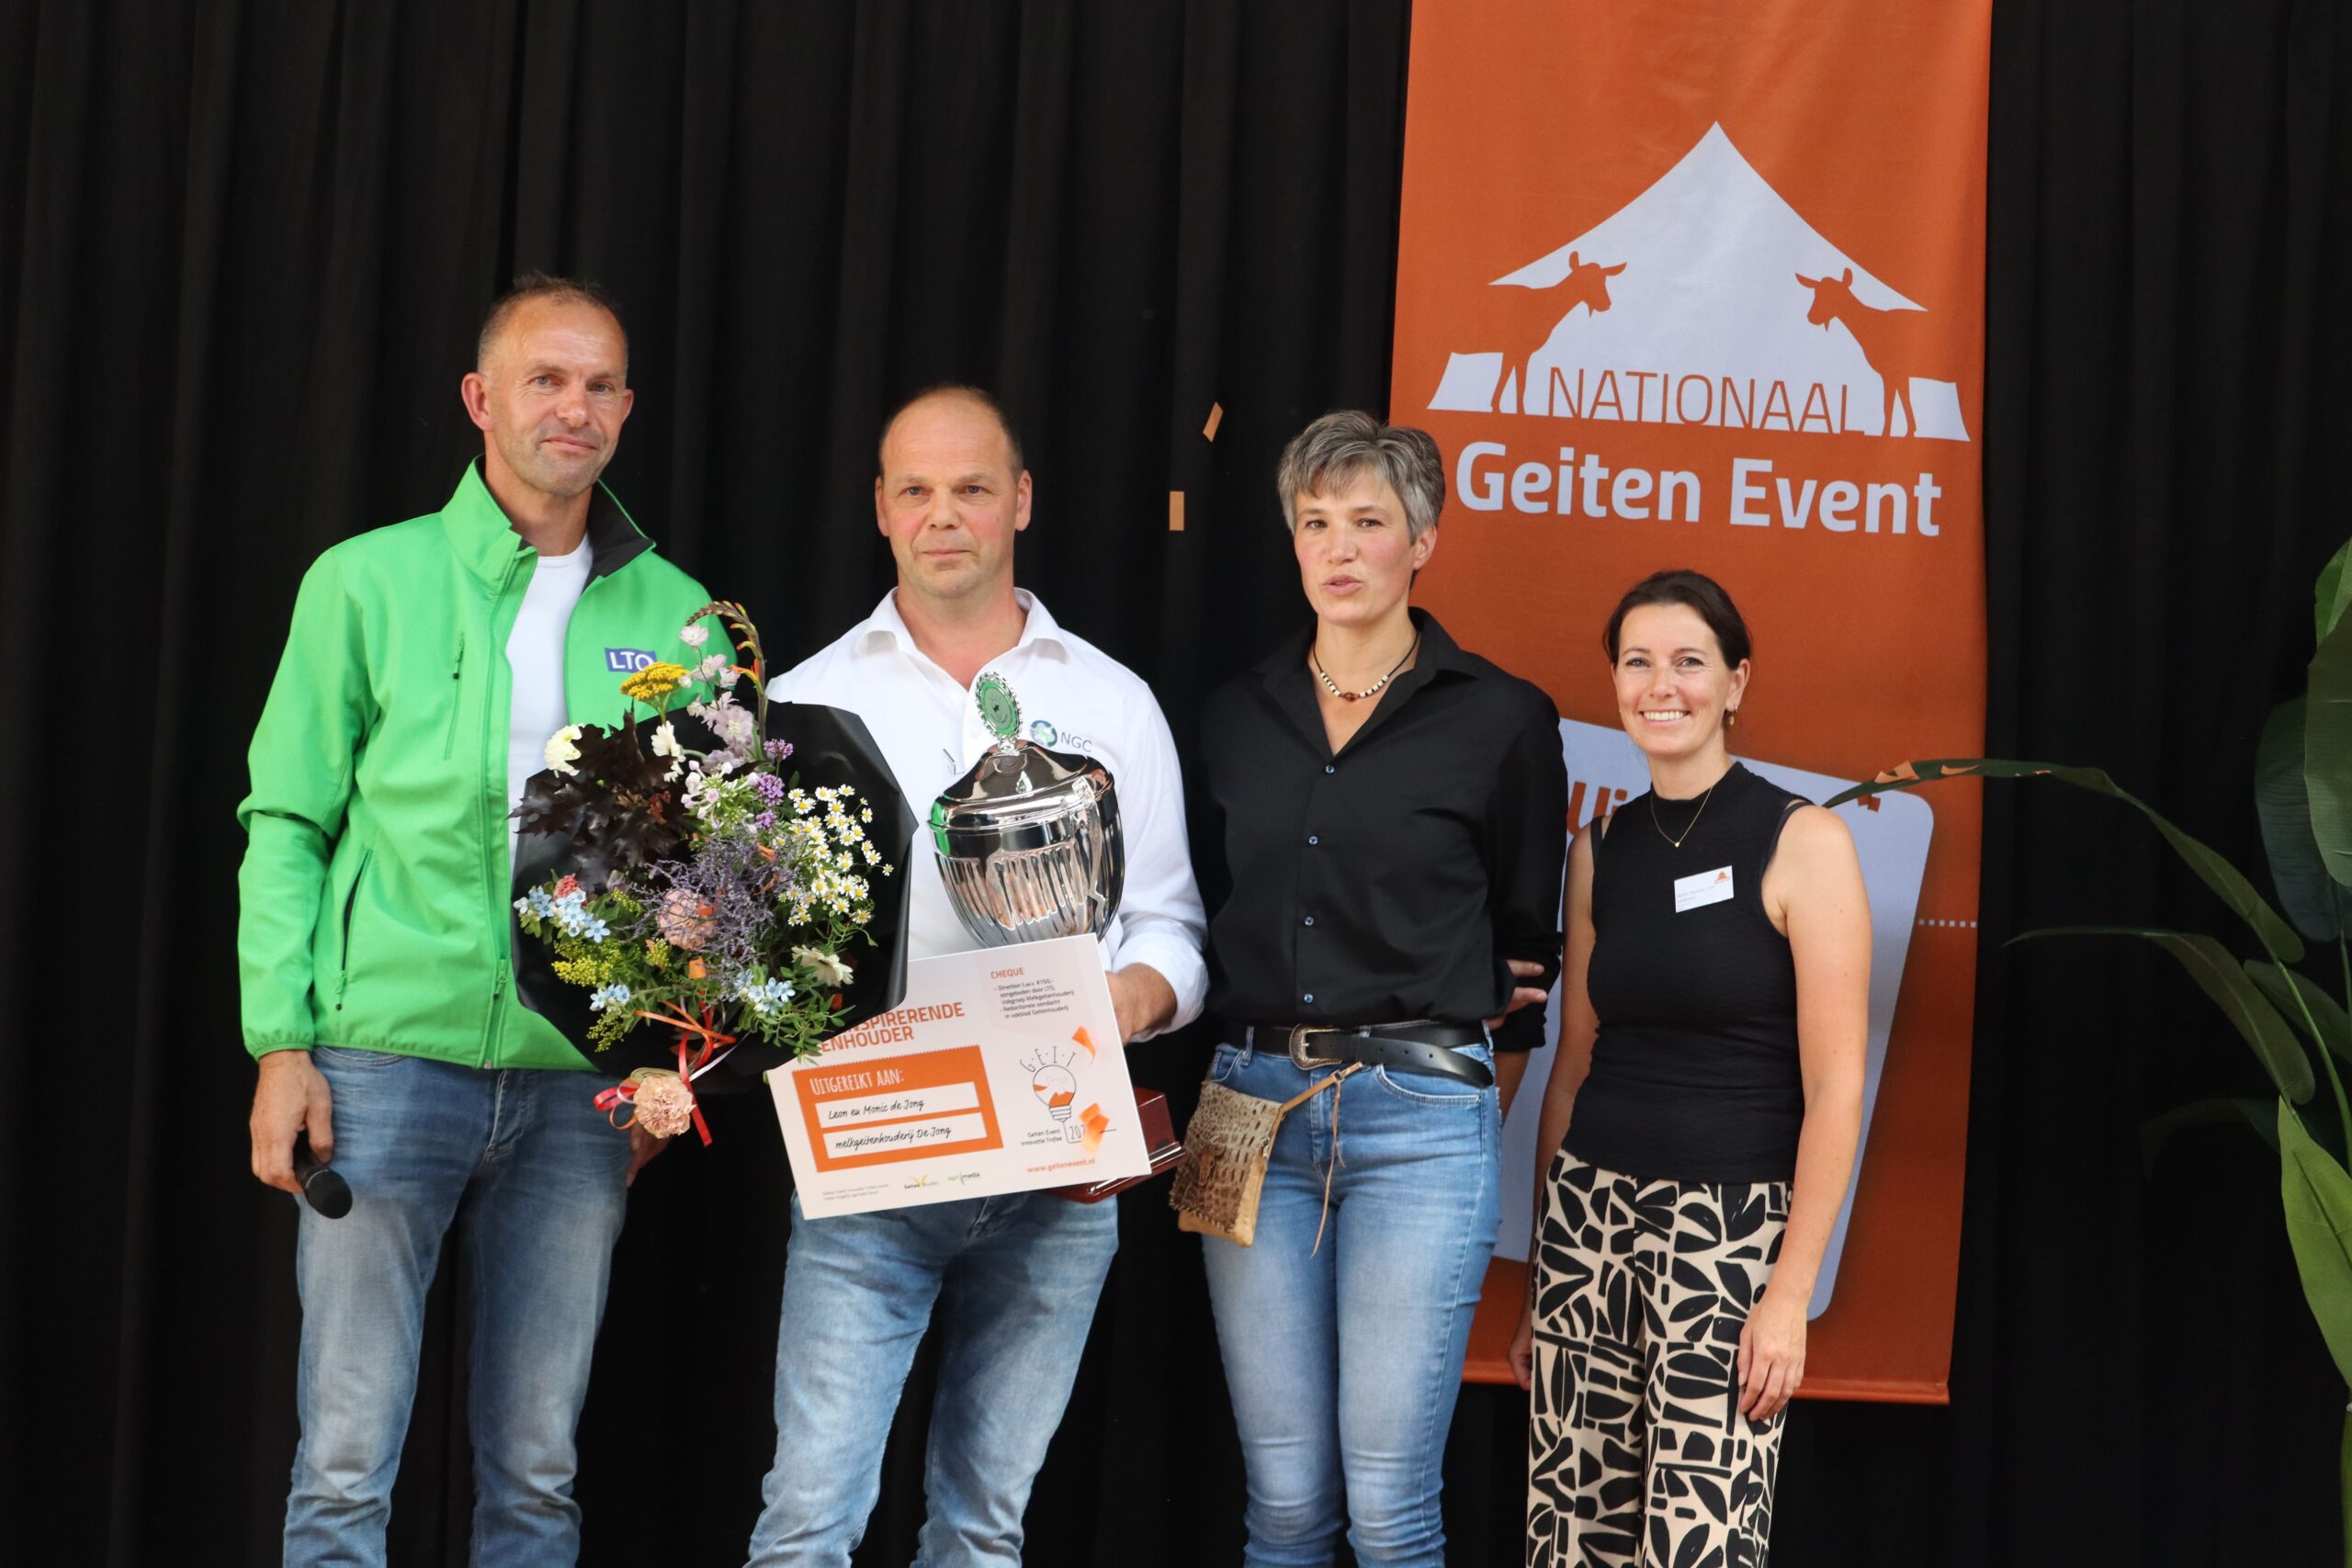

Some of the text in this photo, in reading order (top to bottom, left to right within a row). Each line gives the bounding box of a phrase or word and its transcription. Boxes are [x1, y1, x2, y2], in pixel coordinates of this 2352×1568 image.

[1548, 367, 1864, 435] NATIONAAL
[1456, 441, 1941, 536] Geiten Event
[610, 651, 654, 671] LTO
[1060, 732, 1092, 752] NGC
[990, 967, 1025, 979] CHEQUE
[848, 1002, 965, 1032] SPIRERENDE
[821, 1026, 915, 1053] ENHOUDER
[876, 1068, 905, 1087] AAN:
[829, 1111, 848, 1120] Leon
[890, 1100, 902, 1111] de
[904, 1100, 924, 1111] Jong
[835, 1126, 951, 1150] melkgeitenhouderij De Jong
